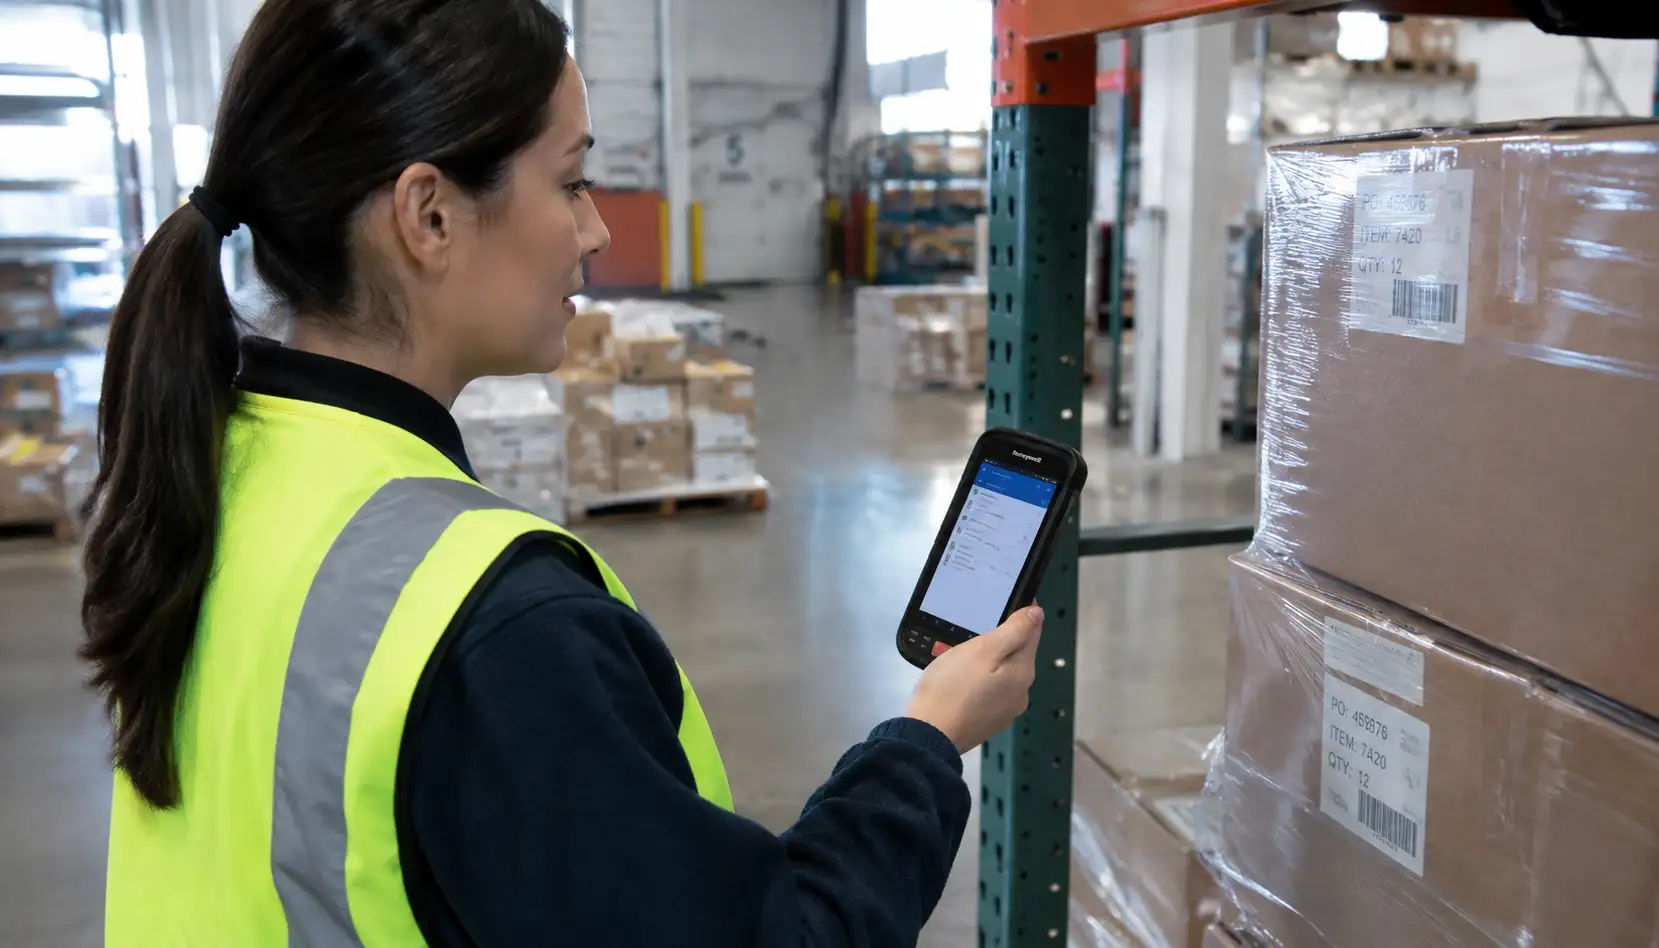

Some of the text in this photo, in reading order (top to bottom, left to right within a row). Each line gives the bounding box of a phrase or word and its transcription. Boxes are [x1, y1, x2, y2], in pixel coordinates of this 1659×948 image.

[726, 132, 746, 168] 5
[1360, 224, 1423, 244] ITEM: 7420
[1358, 256, 1403, 275] QTY: 12
[1331, 696, 1348, 719] PO:
[1329, 724, 1357, 753] ITEM:
[1361, 742, 1387, 770] 7420
[1328, 751, 1370, 789] QTY: 12
